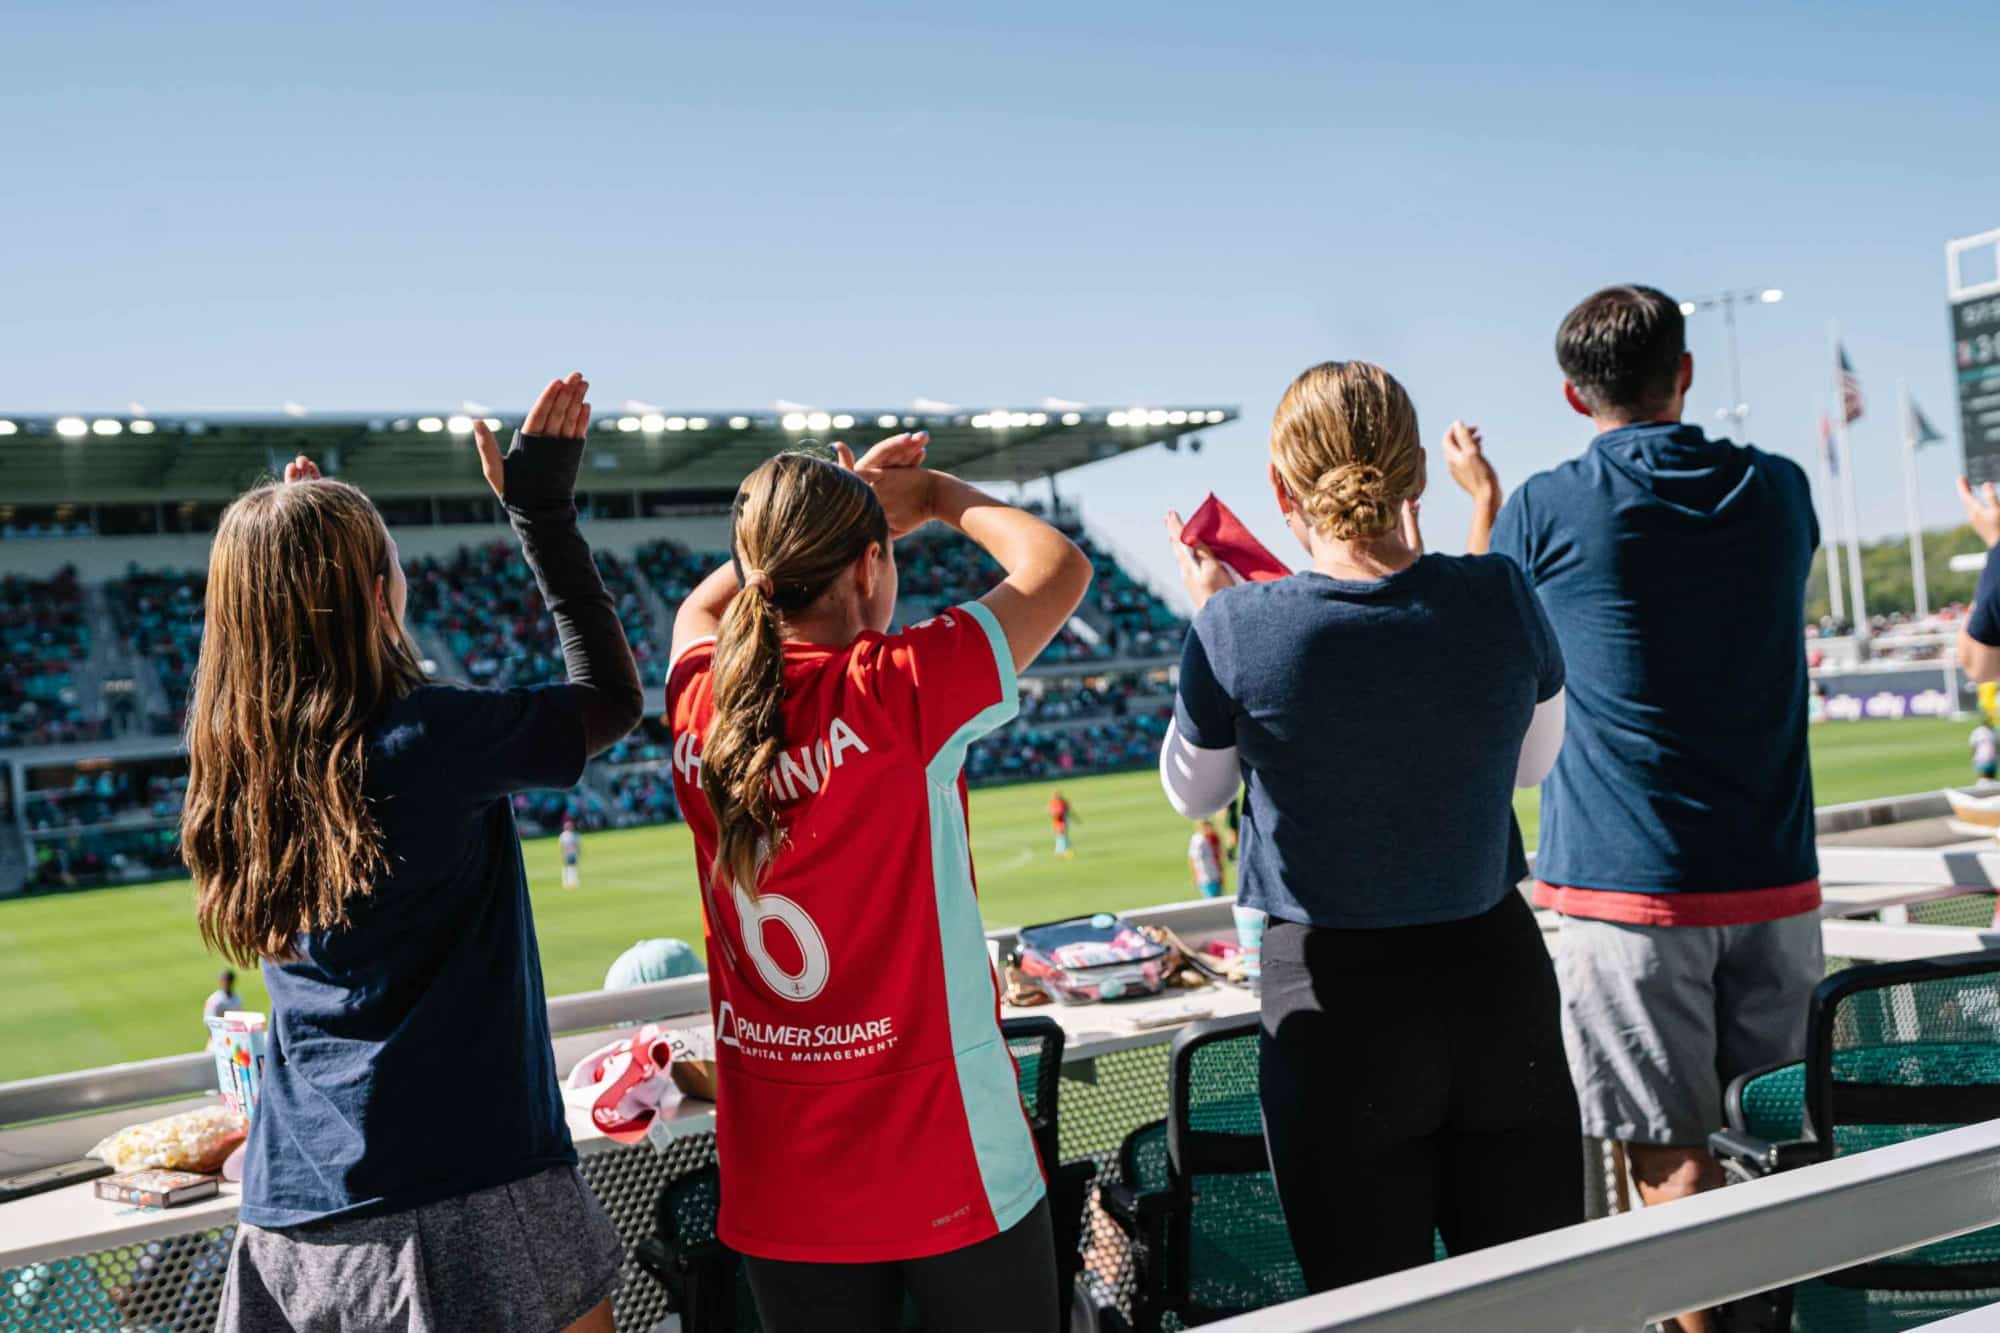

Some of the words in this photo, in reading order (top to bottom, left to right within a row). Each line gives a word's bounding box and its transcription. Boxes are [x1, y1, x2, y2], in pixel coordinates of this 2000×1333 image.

[732, 832, 830, 1002] 6
[737, 1017, 812, 1047] PALMER
[812, 1017, 893, 1047] SQUARE
[739, 1045, 784, 1061] CAPITAL
[791, 1037, 895, 1062] MANAGEMENT
